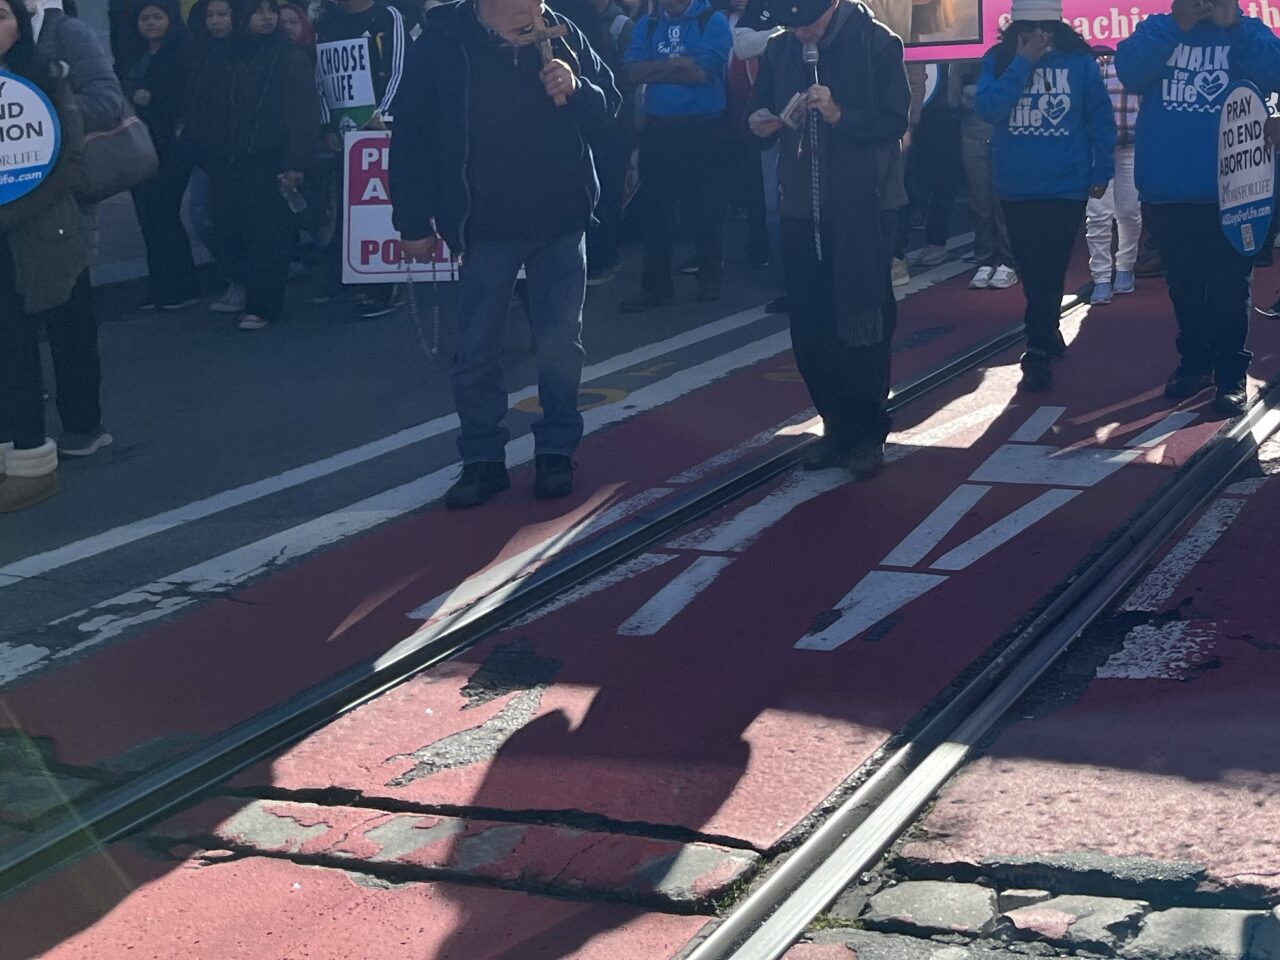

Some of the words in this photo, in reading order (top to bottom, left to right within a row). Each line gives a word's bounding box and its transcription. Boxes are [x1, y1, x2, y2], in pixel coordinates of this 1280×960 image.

[320, 44, 366, 75] CHOOSE
[1166, 43, 1231, 71] WALK
[331, 74, 354, 102] LIFE
[1174, 70, 1189, 81] For
[1162, 79, 1197, 103] Life
[1009, 109, 1043, 127] Life
[1226, 95, 1252, 124] PRAY
[1222, 126, 1234, 150] TO
[1237, 120, 1262, 146] END
[1219, 145, 1271, 178] ABORTION
